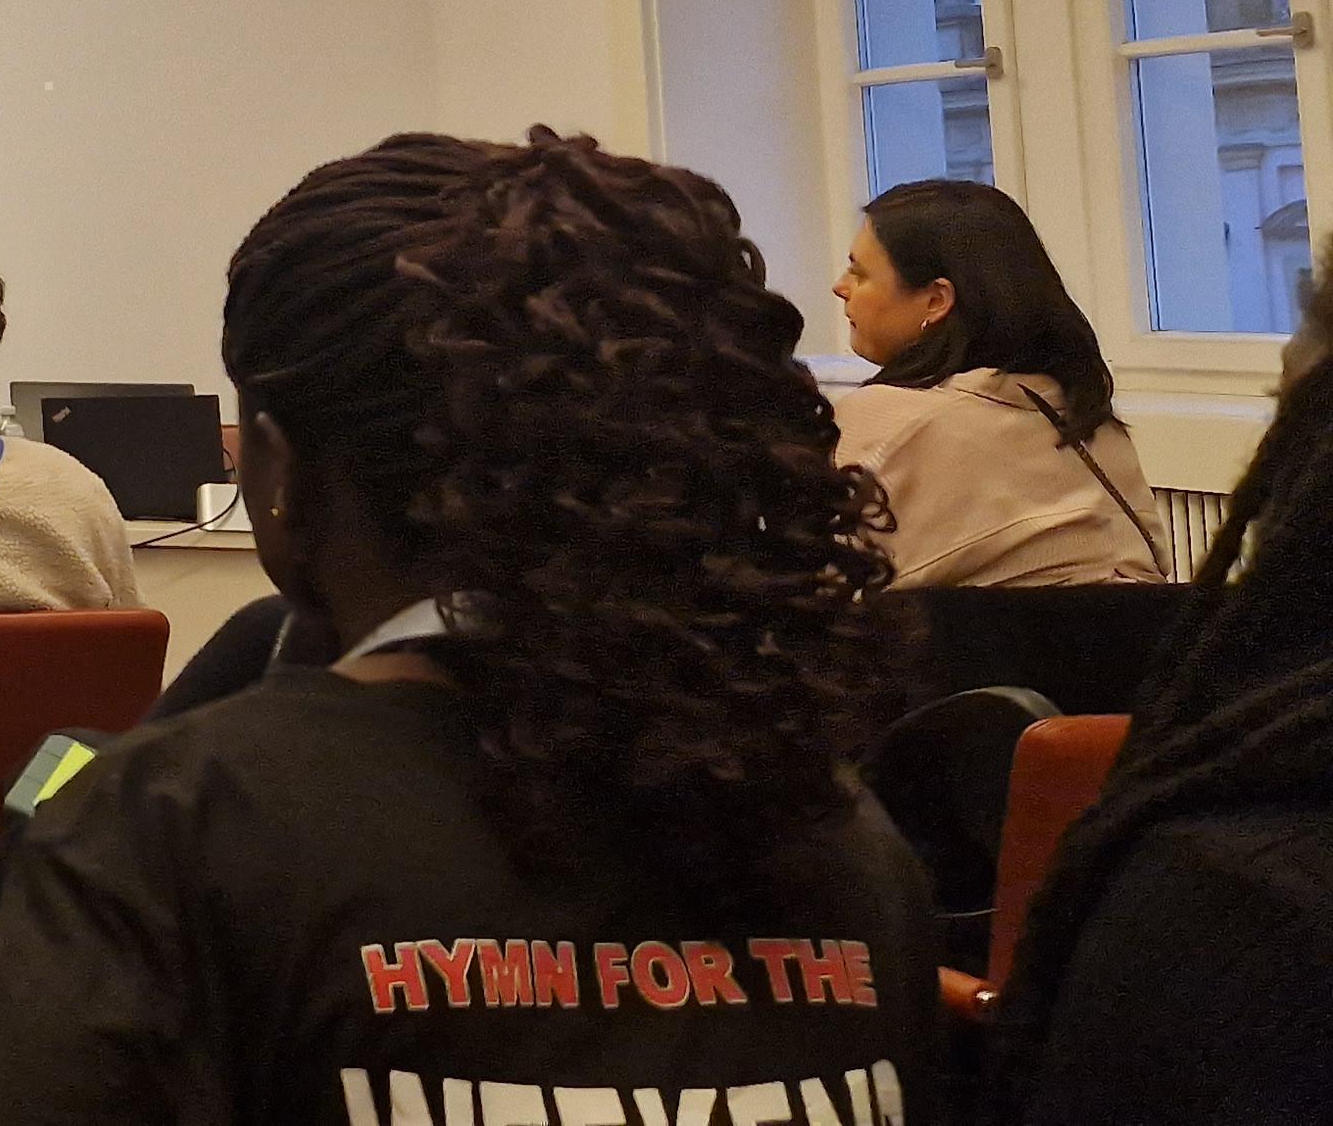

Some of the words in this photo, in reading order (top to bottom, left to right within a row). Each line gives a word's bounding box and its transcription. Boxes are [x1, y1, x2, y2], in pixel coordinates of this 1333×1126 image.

[360, 939, 578, 1013] HYMN
[594, 940, 748, 1009] FOR
[749, 937, 878, 1007] THE
